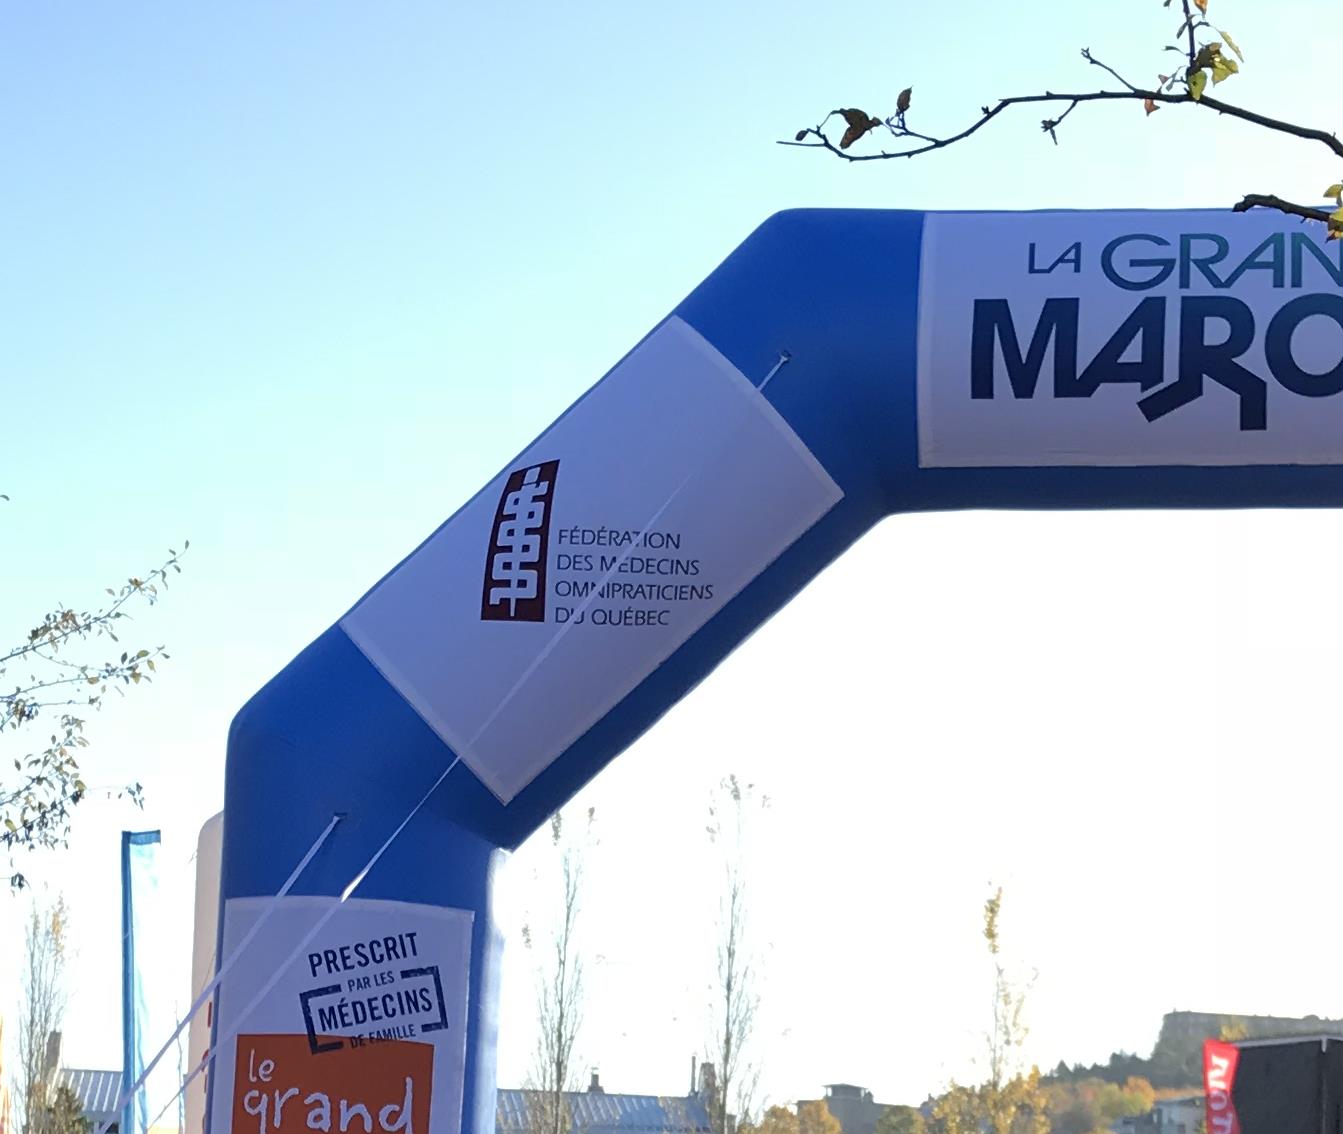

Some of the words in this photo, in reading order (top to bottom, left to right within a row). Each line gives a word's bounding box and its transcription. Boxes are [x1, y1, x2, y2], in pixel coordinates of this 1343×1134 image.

[1026, 241, 1082, 276] LA
[557, 525, 682, 550] FÉDÉRATION
[556, 553, 594, 573] DES
[599, 553, 700, 577] MÉDECINS
[554, 579, 714, 602] OMNIPRATICIENS
[554, 607, 585, 626] DU
[590, 605, 671, 627] QUÉBEC
[308, 932, 418, 978] PRESCRIT
[347, 977, 372, 993] PAR
[373, 970, 396, 988] LES
[317, 986, 434, 1033] MÉDECINS
[349, 1034, 367, 1050] DE
[367, 1023, 417, 1046] FAMILLE
[248, 1048, 276, 1083] le
